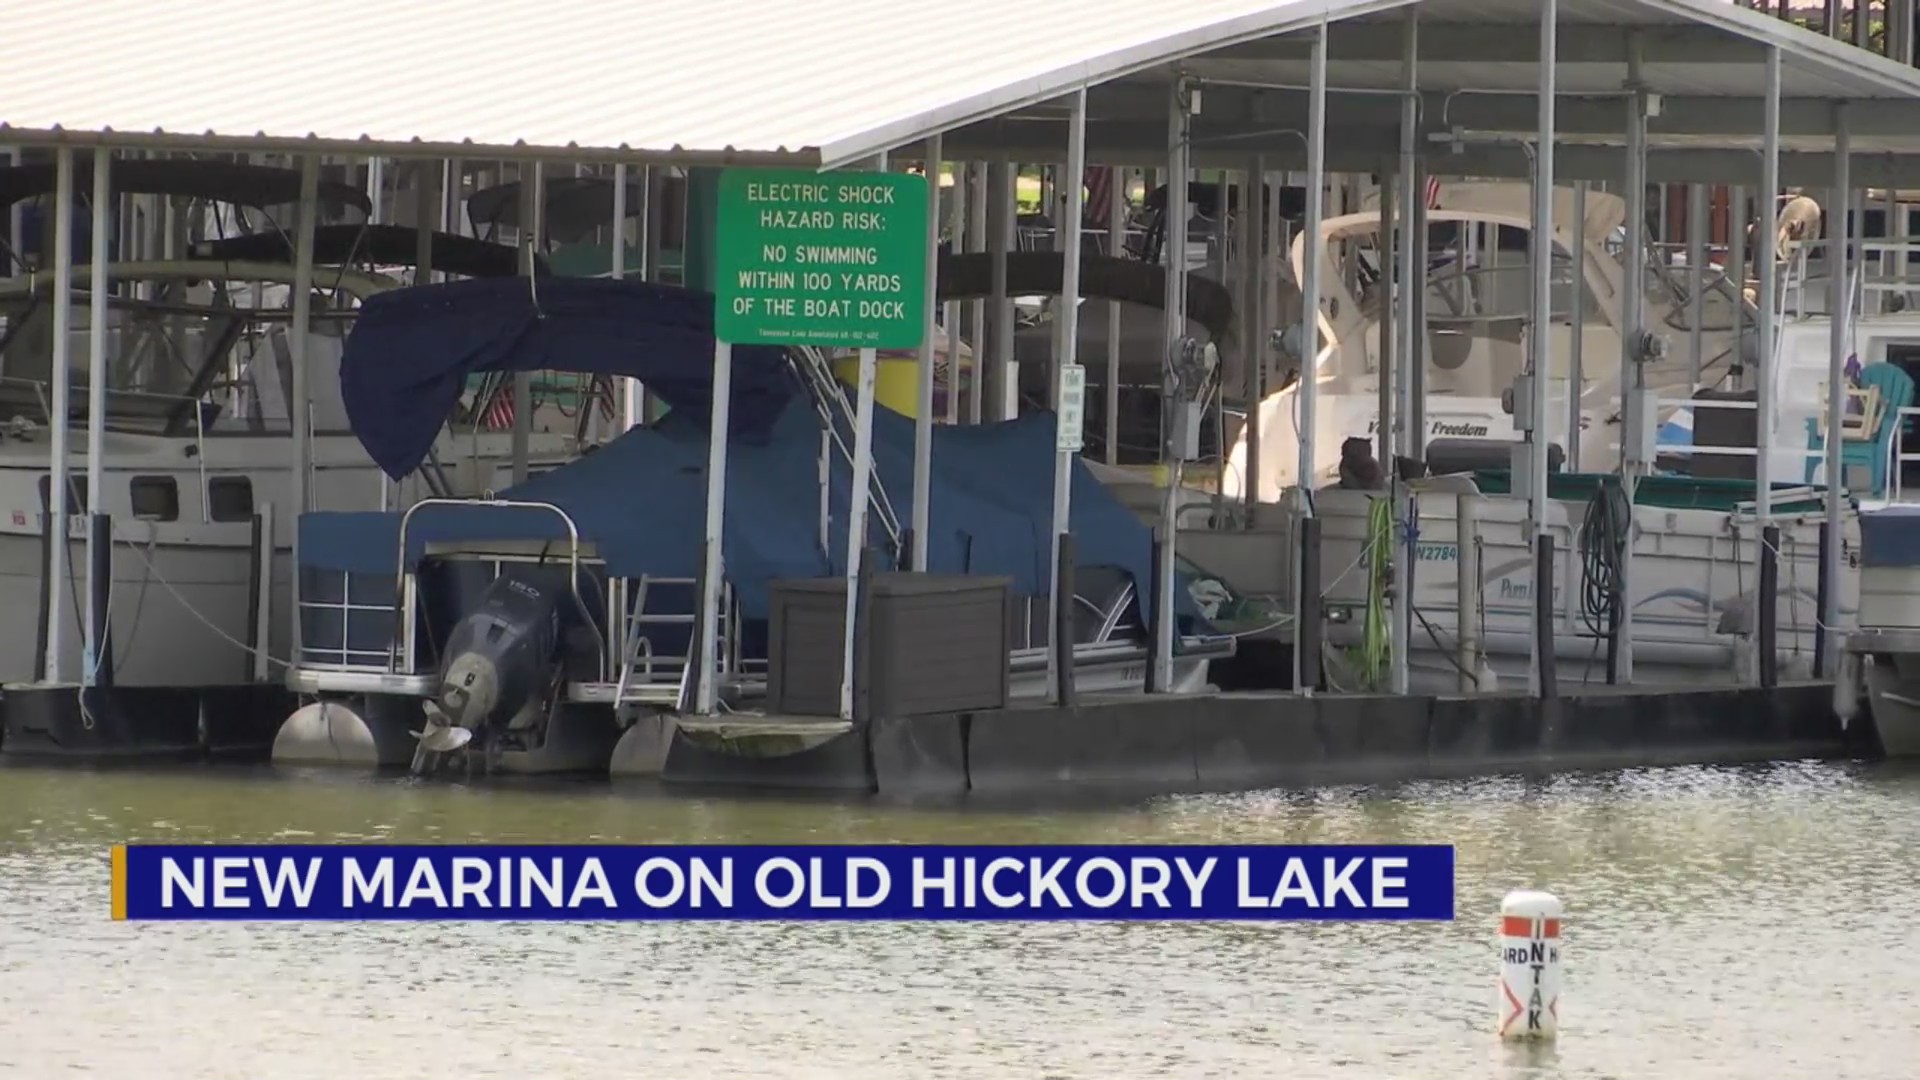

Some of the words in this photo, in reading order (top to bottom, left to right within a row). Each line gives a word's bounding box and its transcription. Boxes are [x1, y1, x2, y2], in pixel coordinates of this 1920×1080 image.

[747, 183, 829, 202] ELECTRIC
[838, 186, 894, 204] SHOCK
[760, 210, 834, 229] HAZARD
[842, 213, 886, 230] RISK:
[763, 245, 786, 262] NO
[795, 246, 877, 265] SWIMMING
[738, 271, 794, 289] WITHIN
[803, 273, 831, 290] 100
[841, 274, 901, 292] YARDS
[732, 298, 755, 315] OF
[763, 298, 795, 316] THE
[804, 300, 851, 317] BOAT
[859, 302, 904, 319] DOCK
[1431, 421, 1488, 436] Freedom
